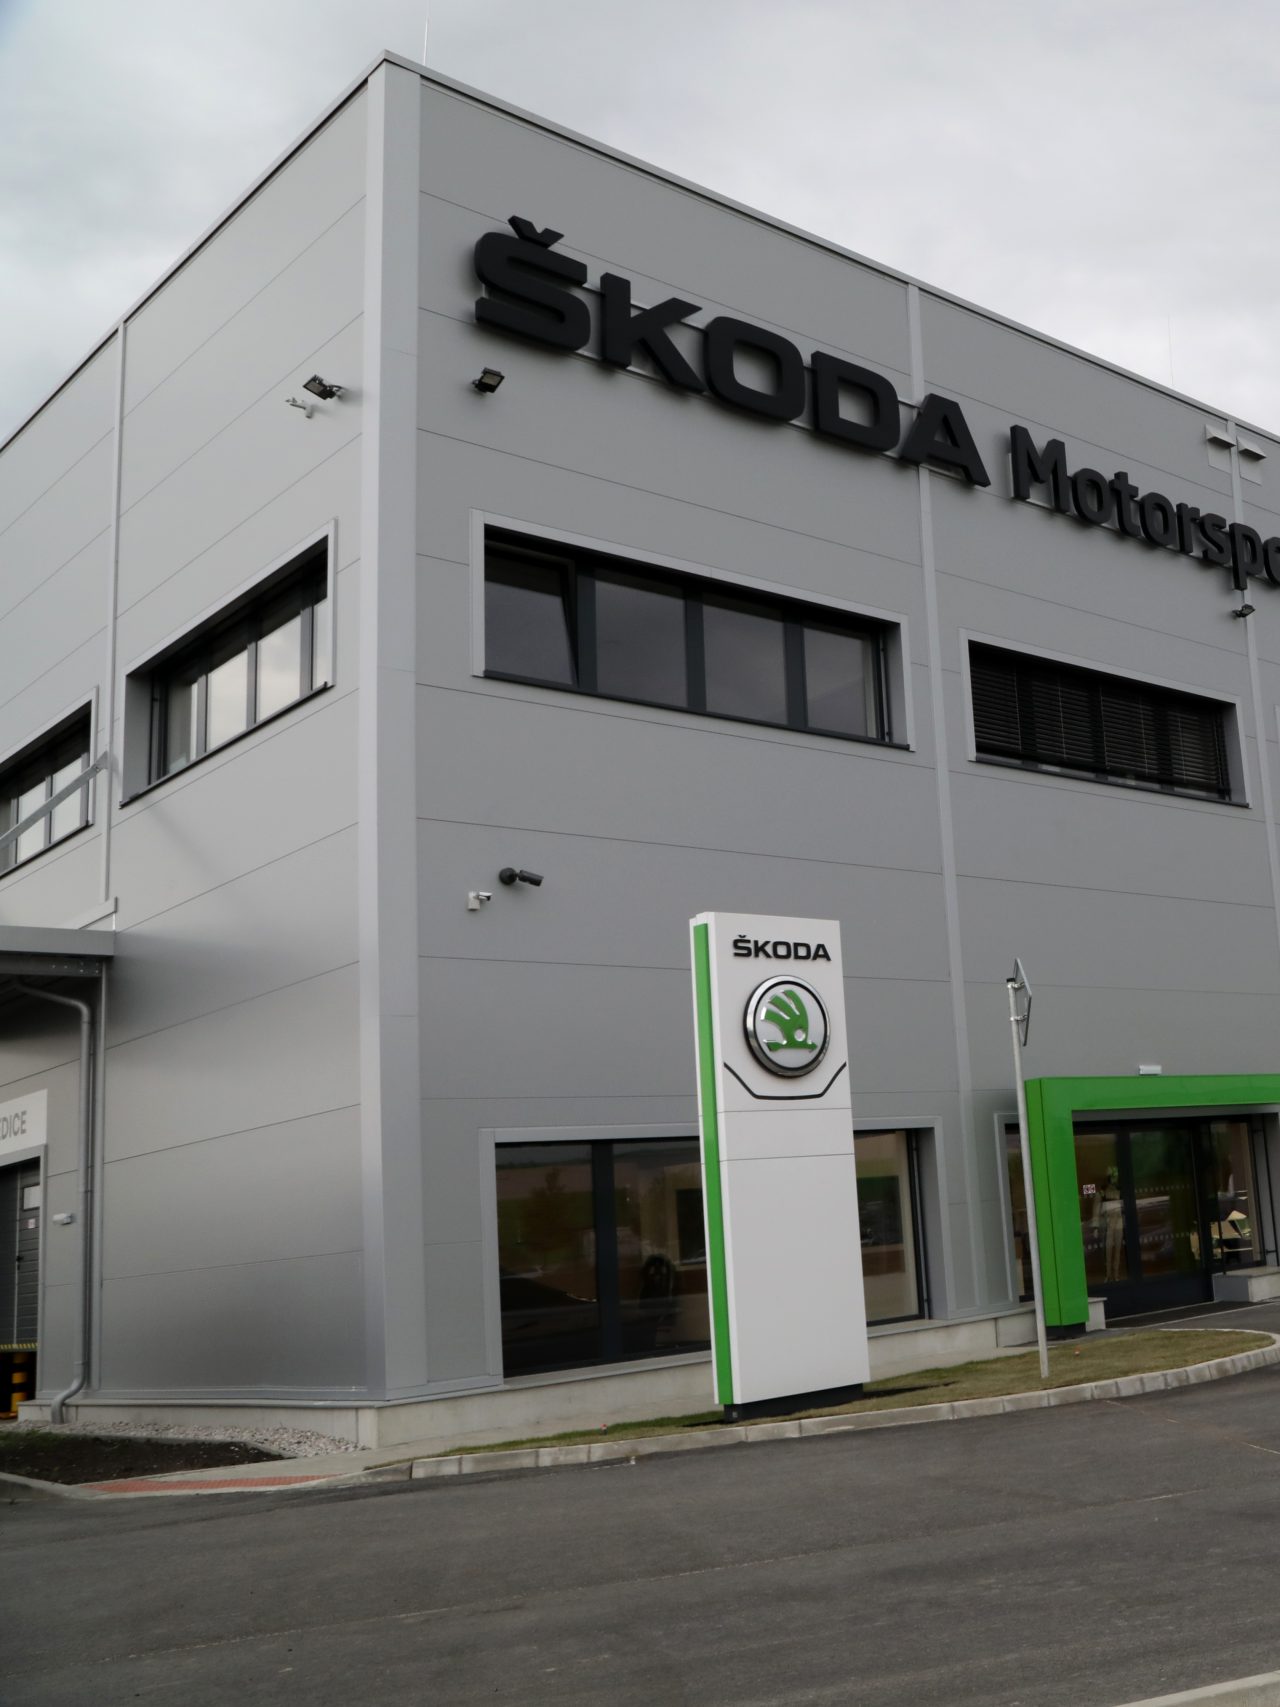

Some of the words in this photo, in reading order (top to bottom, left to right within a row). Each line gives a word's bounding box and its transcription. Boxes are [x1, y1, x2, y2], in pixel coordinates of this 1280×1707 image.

[474, 215, 991, 487] ŠKODA
[732, 934, 832, 962] ŠKODA
[0, 1110, 28, 1140] DICE
